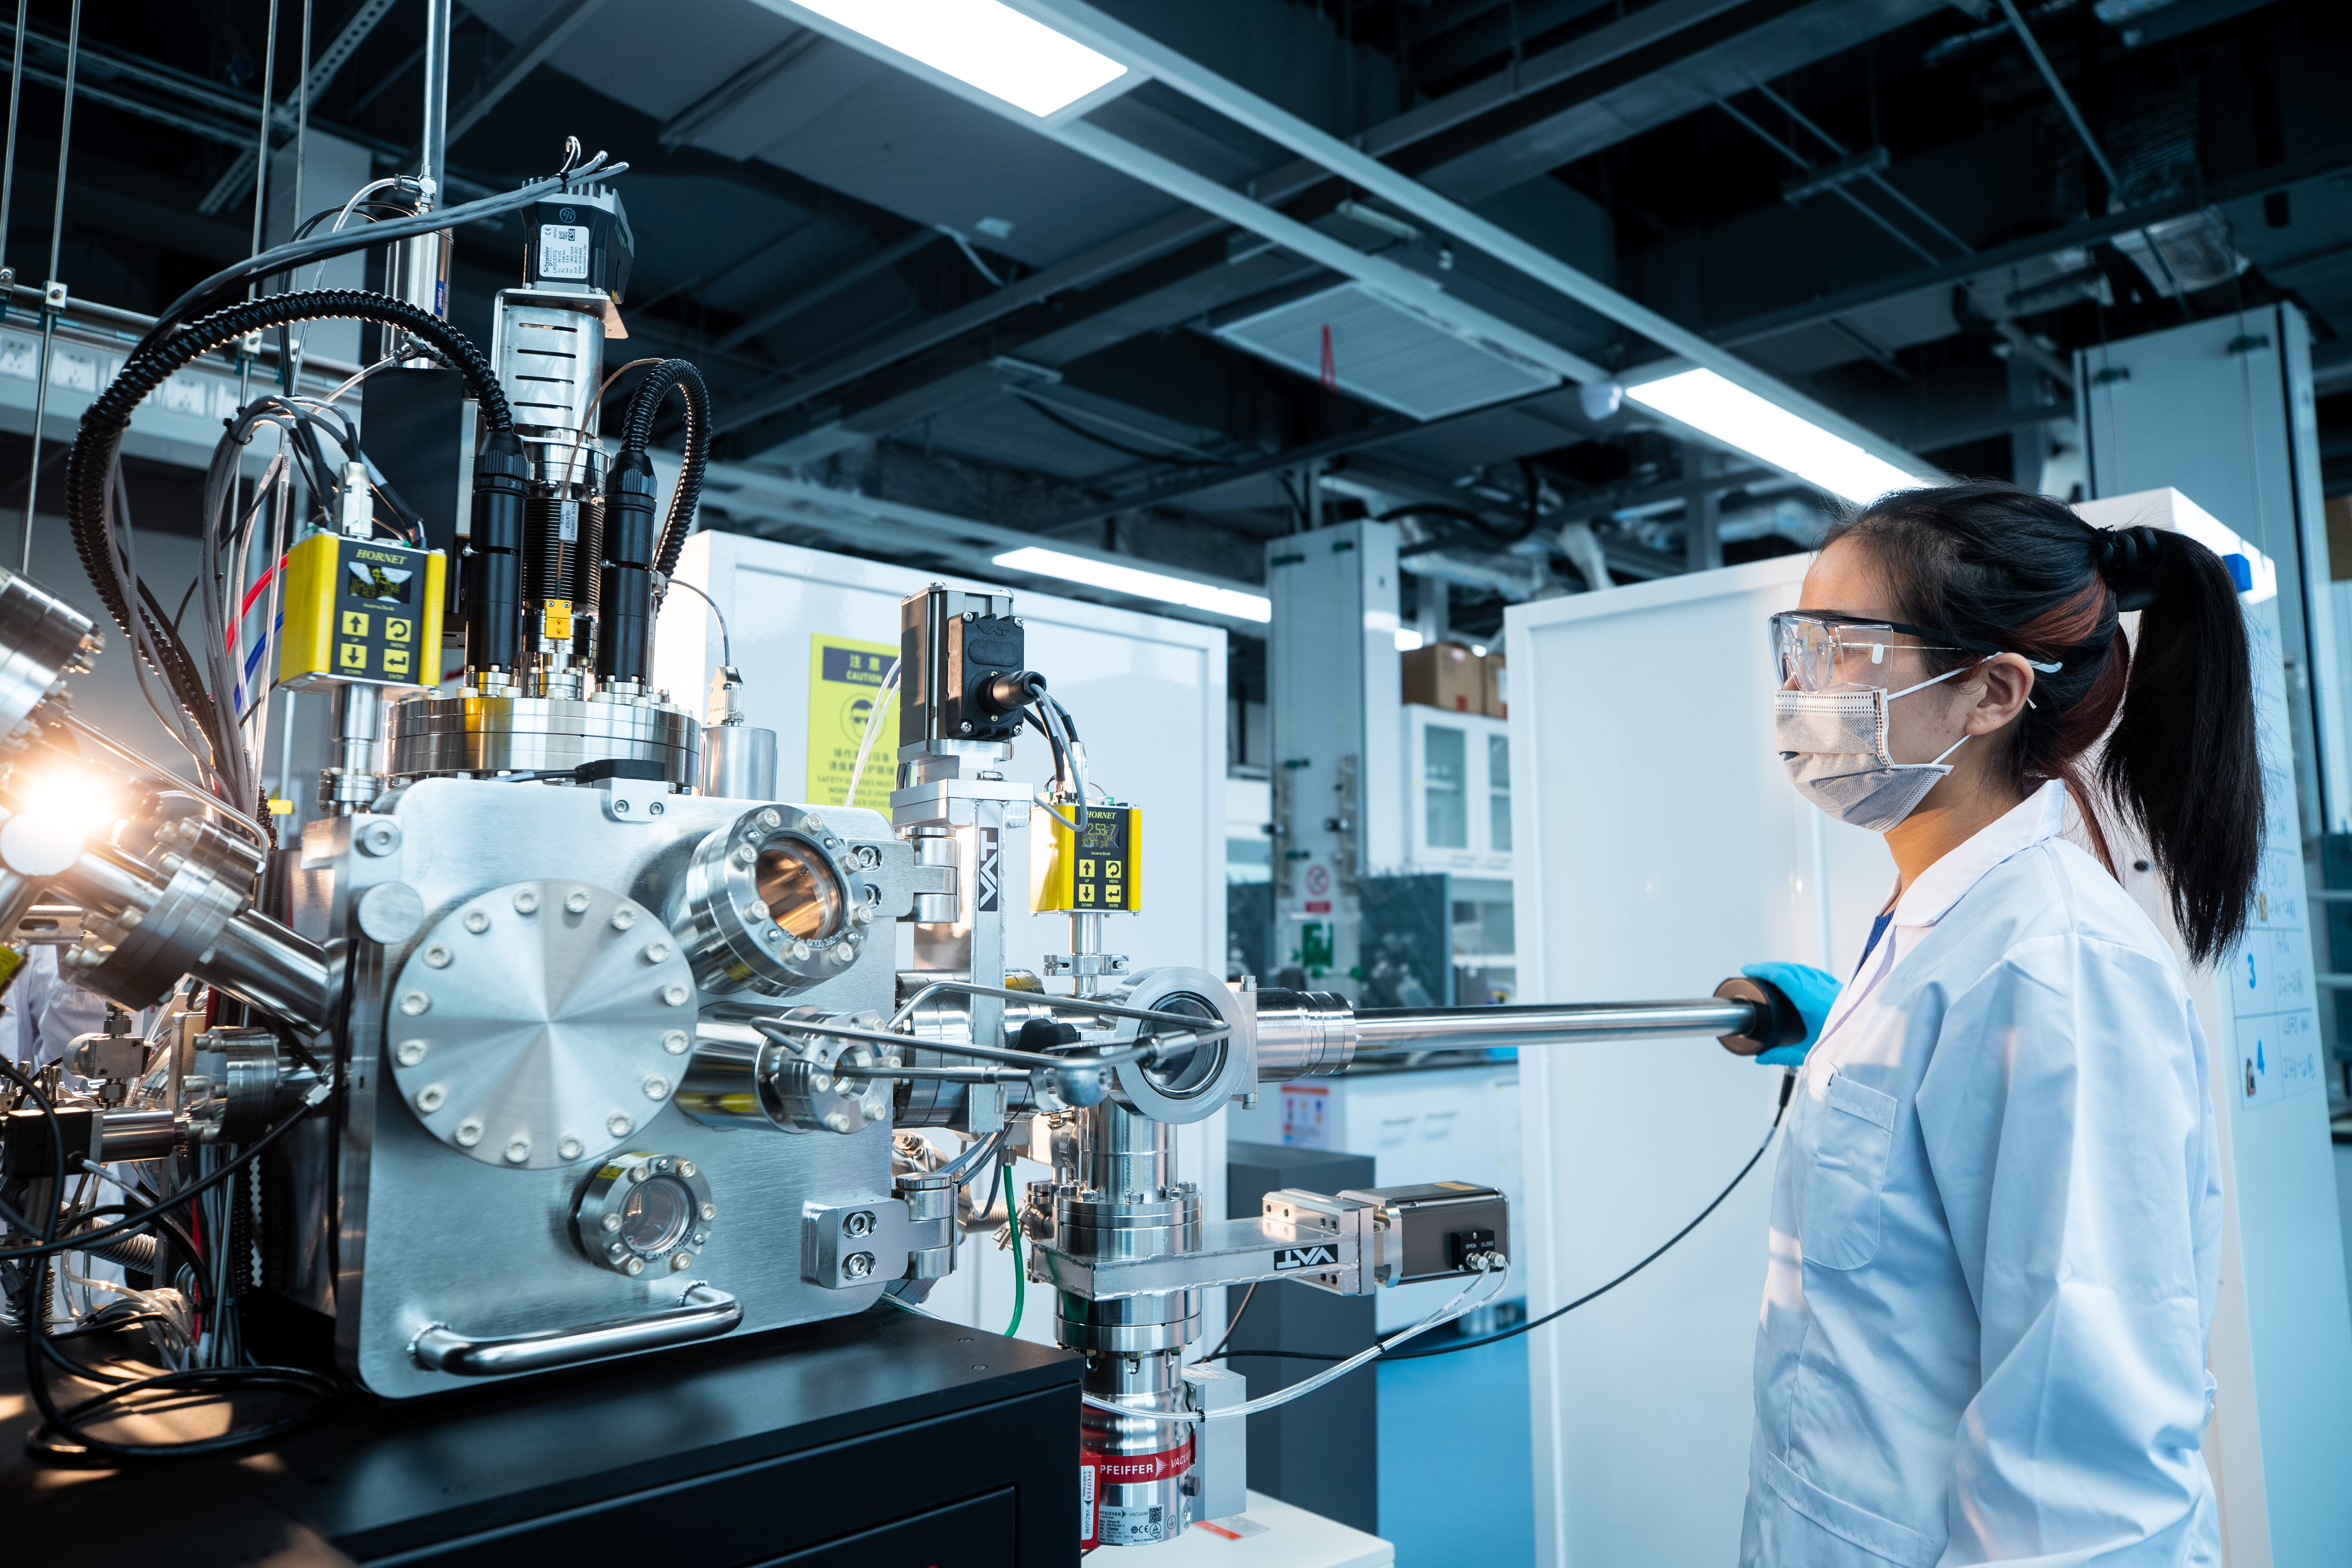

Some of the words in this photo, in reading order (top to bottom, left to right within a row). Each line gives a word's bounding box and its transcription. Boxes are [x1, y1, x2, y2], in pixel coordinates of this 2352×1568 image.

[355, 549, 407, 565] HORNET
[846, 670, 883, 684] CAUTION
[818, 776, 843, 784] SAFETY
[868, 799, 890, 808] DEVIC
[980, 830, 997, 908] VAT
[2248, 953, 2256, 989] 3
[2257, 1039, 2265, 1076] 4
[1276, 1246, 1336, 1270] VAT
[1101, 1464, 1153, 1475] PFEIFFER
[1171, 1450, 1191, 1468] VACUU
